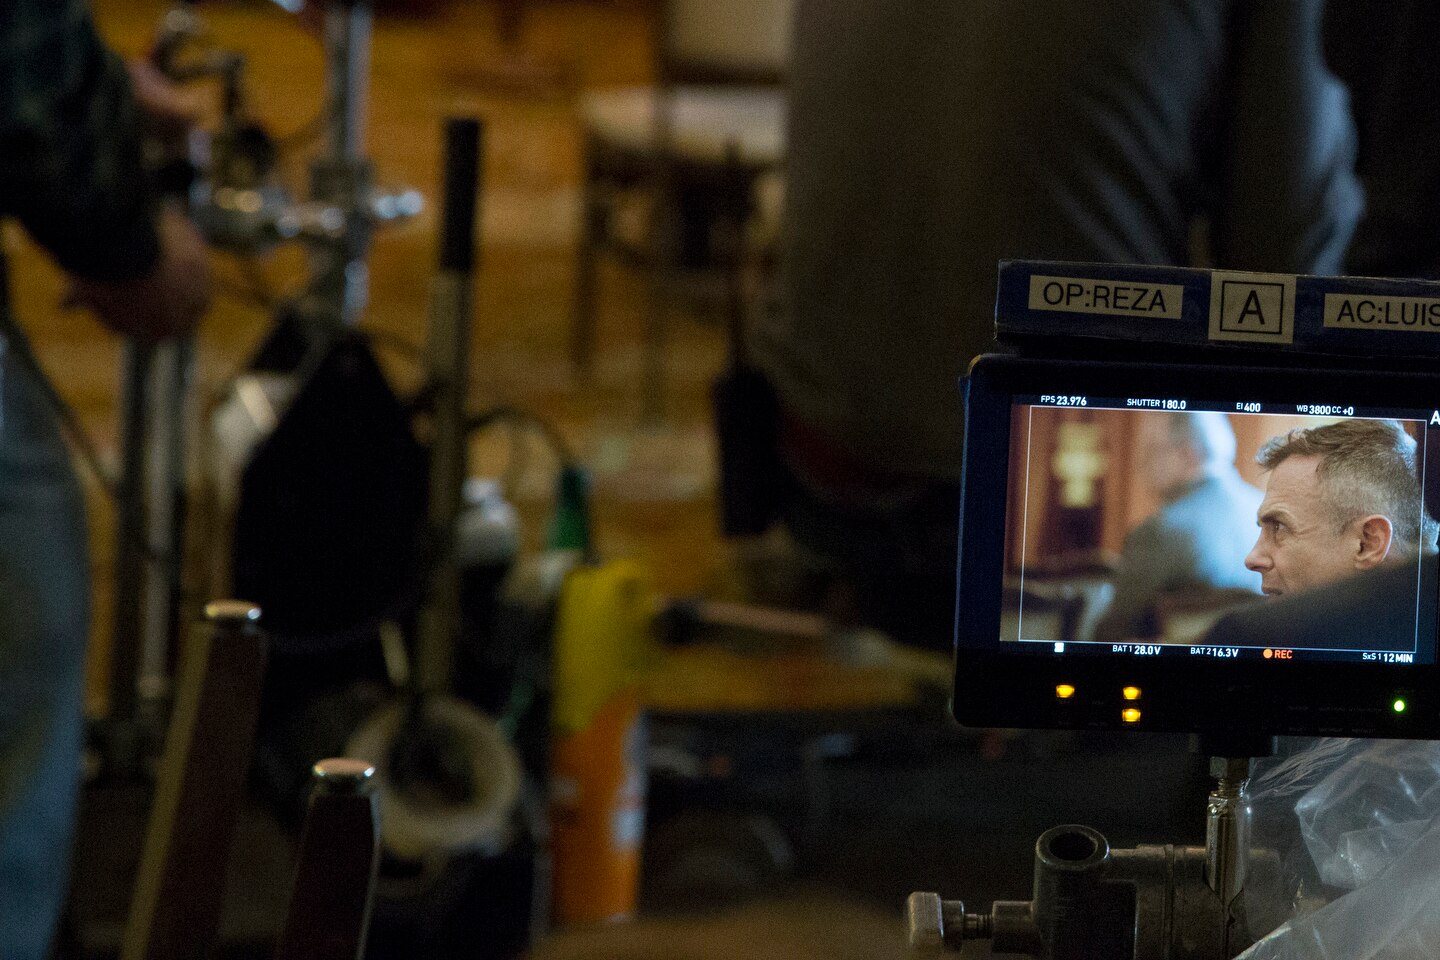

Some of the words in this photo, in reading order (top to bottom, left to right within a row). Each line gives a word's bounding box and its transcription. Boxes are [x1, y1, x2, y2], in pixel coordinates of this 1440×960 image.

[1043, 281, 1167, 313] OP:REZA
[1237, 290, 1265, 325] A
[1040, 395, 1056, 404] FPS
[1056, 395, 1088, 407] 23.976
[1126, 398, 1161, 408] SHUTTER
[1161, 399, 1187, 410] 180.0
[1244, 402, 1261, 413] 400
[1296, 404, 1308, 413] WB
[1308, 404, 1331, 416] 3800
[1331, 405, 1342, 414] CC
[1342, 406, 1354, 416] +0
[1112, 644, 1127, 653] BAT
[1190, 646, 1205, 655] BAT
[1274, 649, 1293, 659] REC
